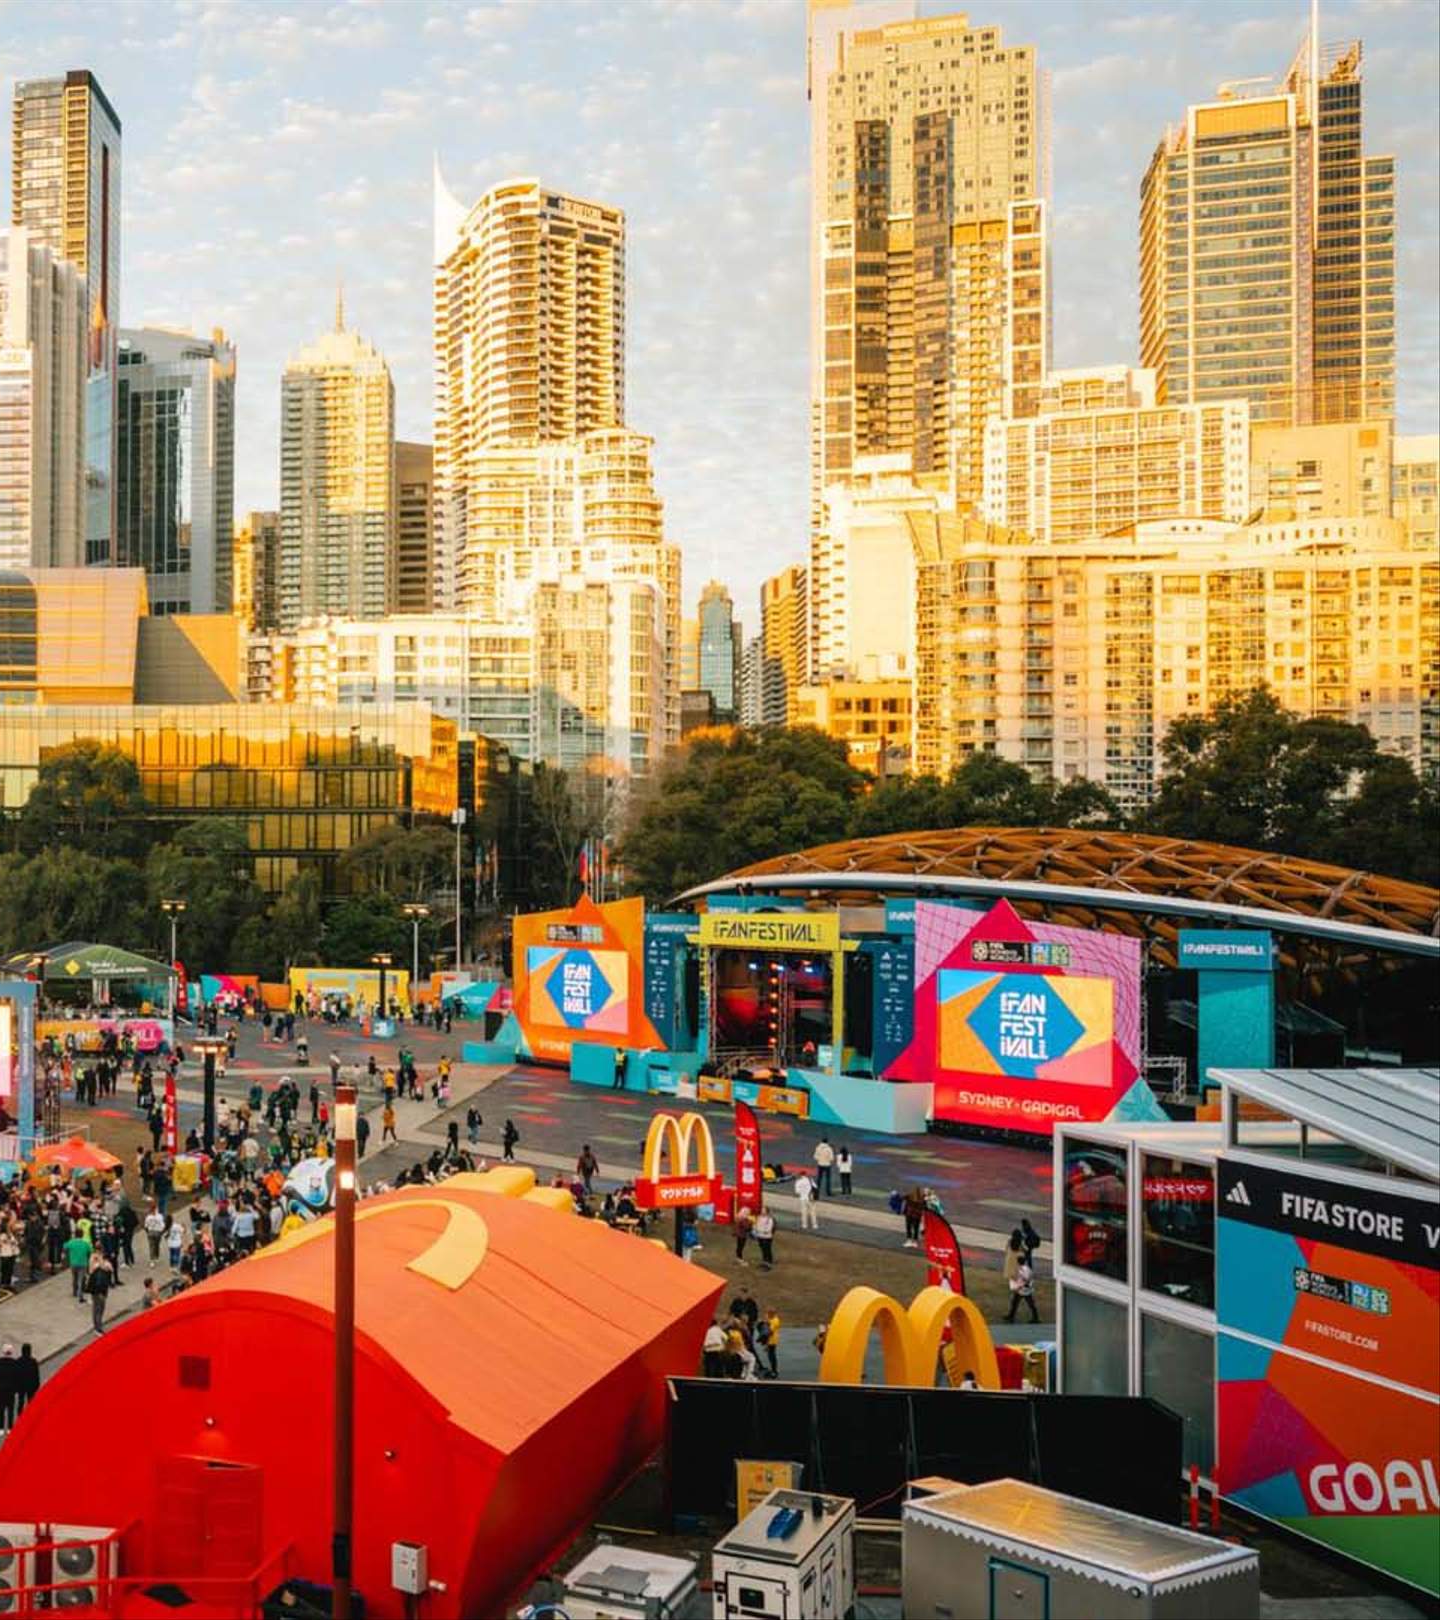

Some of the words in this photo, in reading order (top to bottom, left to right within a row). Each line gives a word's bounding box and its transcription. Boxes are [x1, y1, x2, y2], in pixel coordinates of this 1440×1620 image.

[1000, 1014, 1047, 1037] FEST
[959, 1091, 1014, 1109] SYDNEY
[1021, 1099, 1085, 1119] GADIGAL
[1281, 1192, 1330, 1225] FIFA
[1331, 1203, 1404, 1243] STORE
